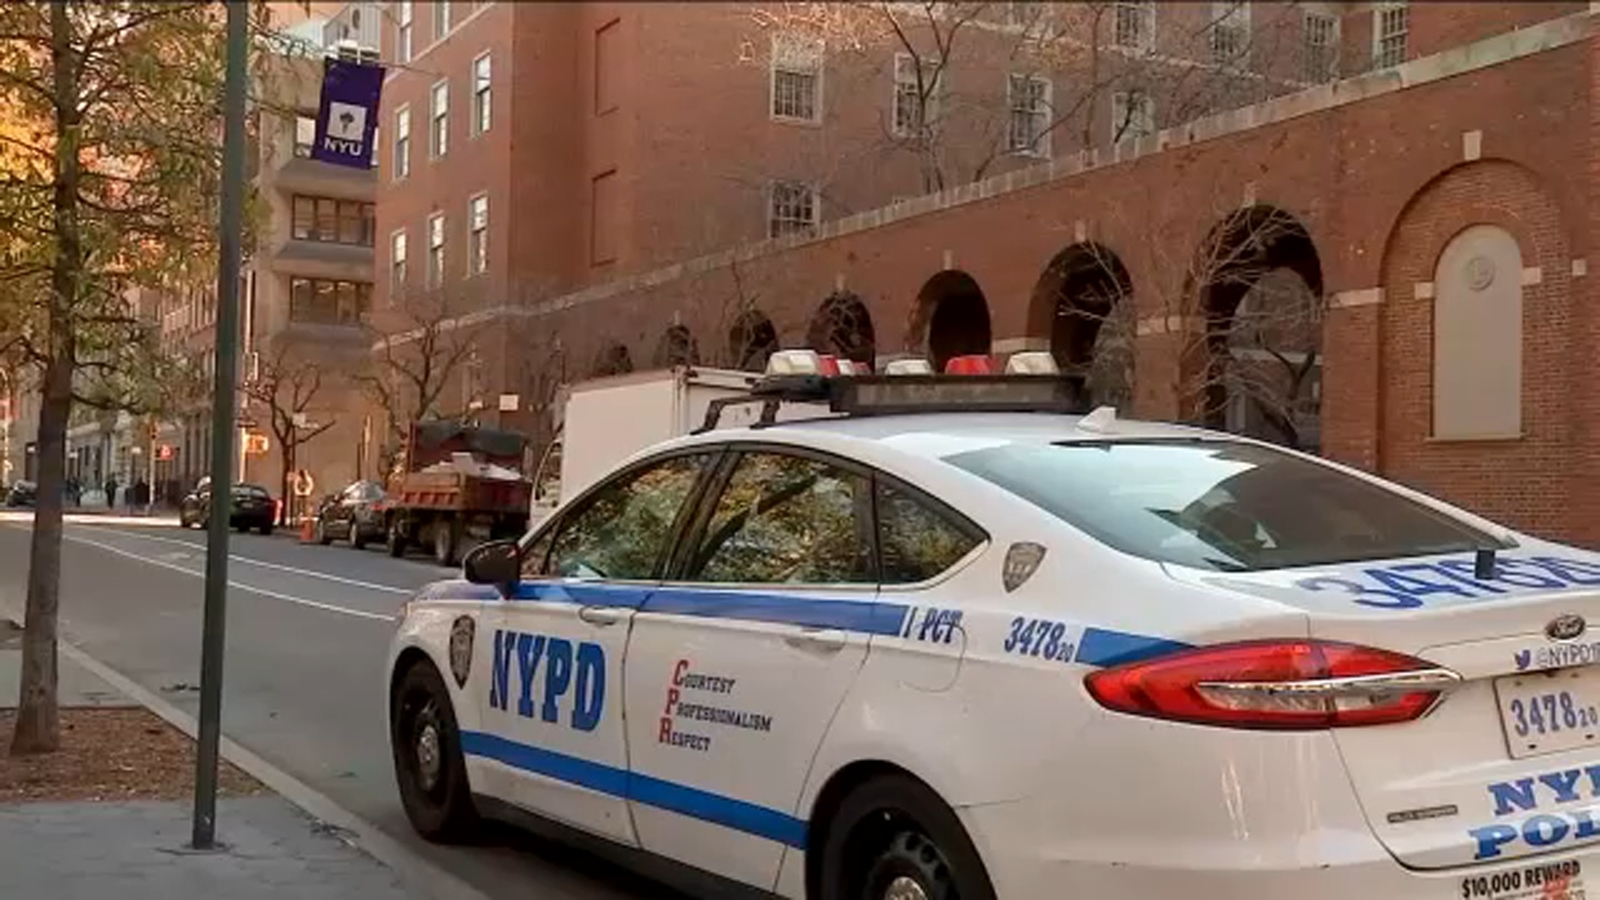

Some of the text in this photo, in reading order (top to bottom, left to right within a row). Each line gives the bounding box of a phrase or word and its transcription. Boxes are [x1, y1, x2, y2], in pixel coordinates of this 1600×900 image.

[324, 137, 363, 156] NYU
[918, 607, 963, 644] PCT
[489, 629, 606, 733] NYPD
[1462, 871, 1521, 898] $10,000
[1525, 859, 1580, 887] REWARD
